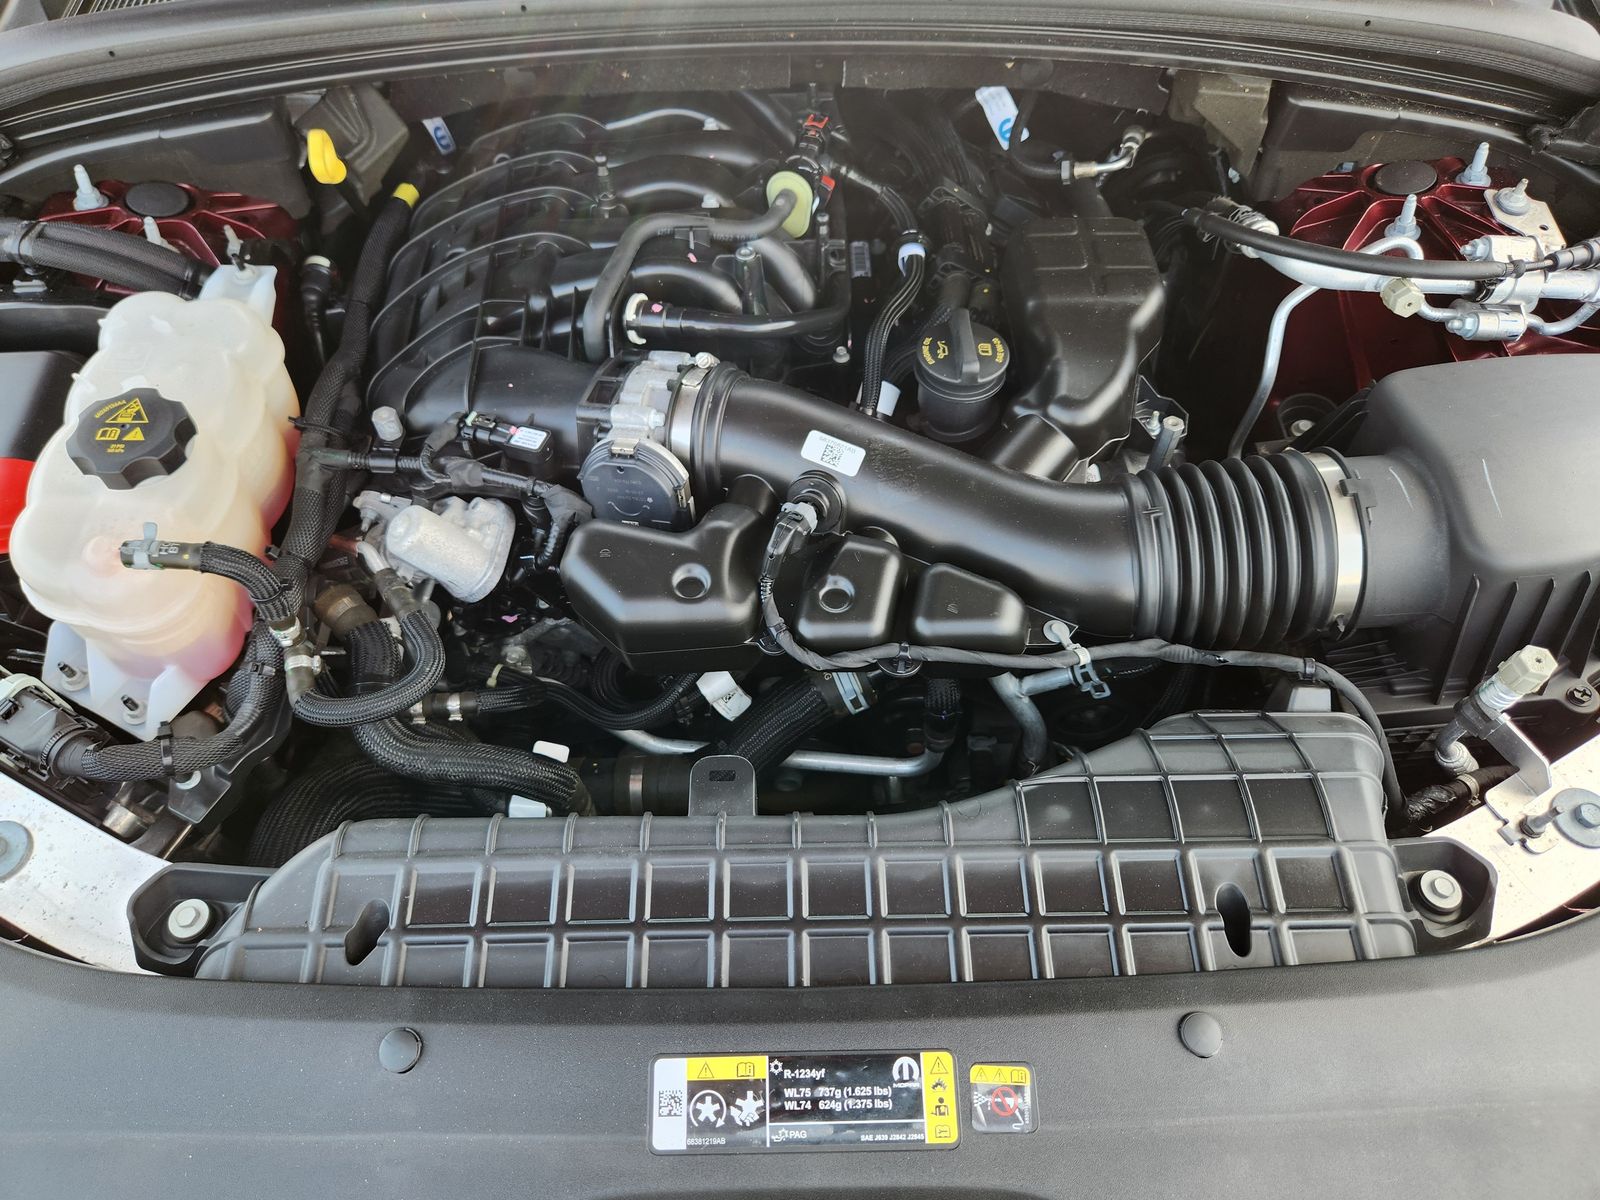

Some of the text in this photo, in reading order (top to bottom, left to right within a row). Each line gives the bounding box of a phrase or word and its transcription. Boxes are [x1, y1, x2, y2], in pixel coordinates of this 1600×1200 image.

[783, 1068, 826, 1080] R-1234yf
[784, 1085, 892, 1099] WL75 737g (1.625 lbs)
[784, 1098, 893, 1111] WL74 624g (1.375 lbs)
[790, 1130, 807, 1139] PAG
[860, 1134, 874, 1142] SAE
